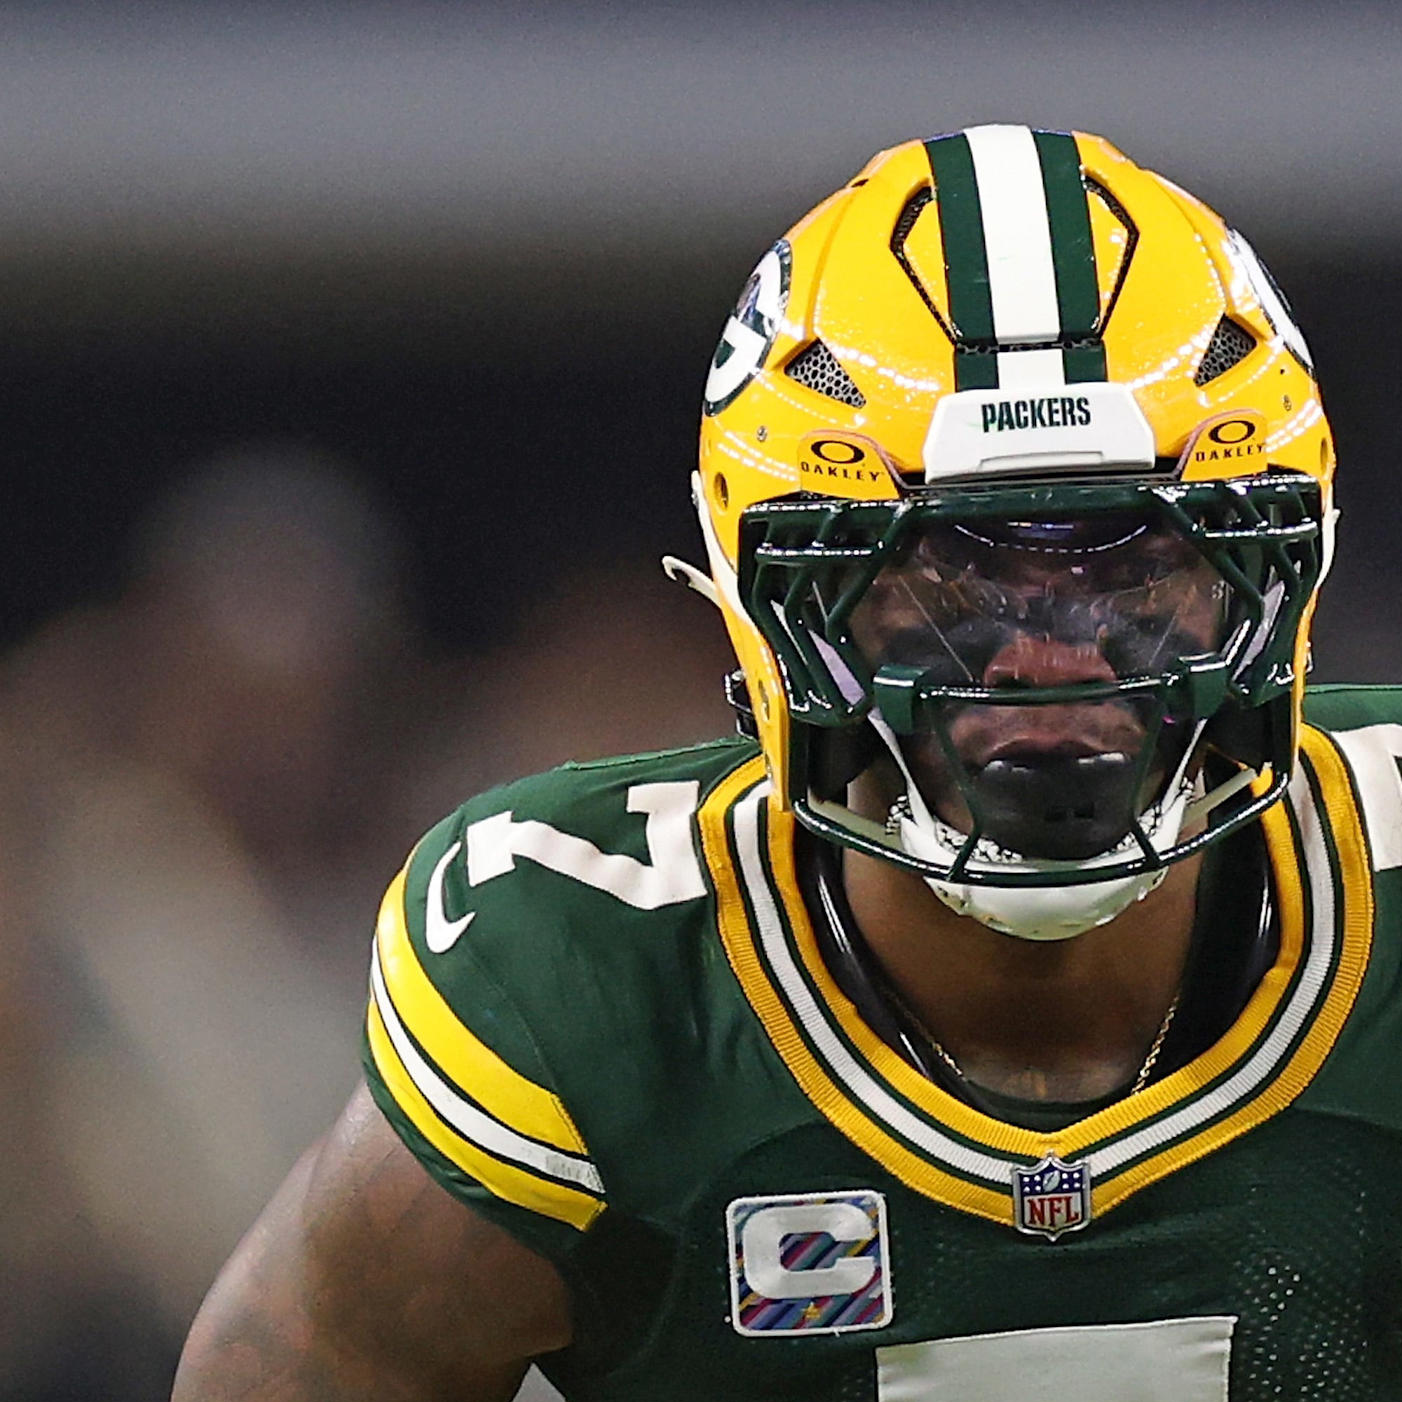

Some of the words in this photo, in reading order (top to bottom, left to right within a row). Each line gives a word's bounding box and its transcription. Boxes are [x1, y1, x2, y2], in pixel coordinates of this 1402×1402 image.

[981, 397, 1091, 433] PACKERS
[1195, 443, 1265, 462] OAKLEY
[801, 461, 880, 482] OAKLEY
[467, 780, 708, 910] 7
[1027, 1195, 1080, 1227] NFL
[742, 1202, 877, 1300] C
